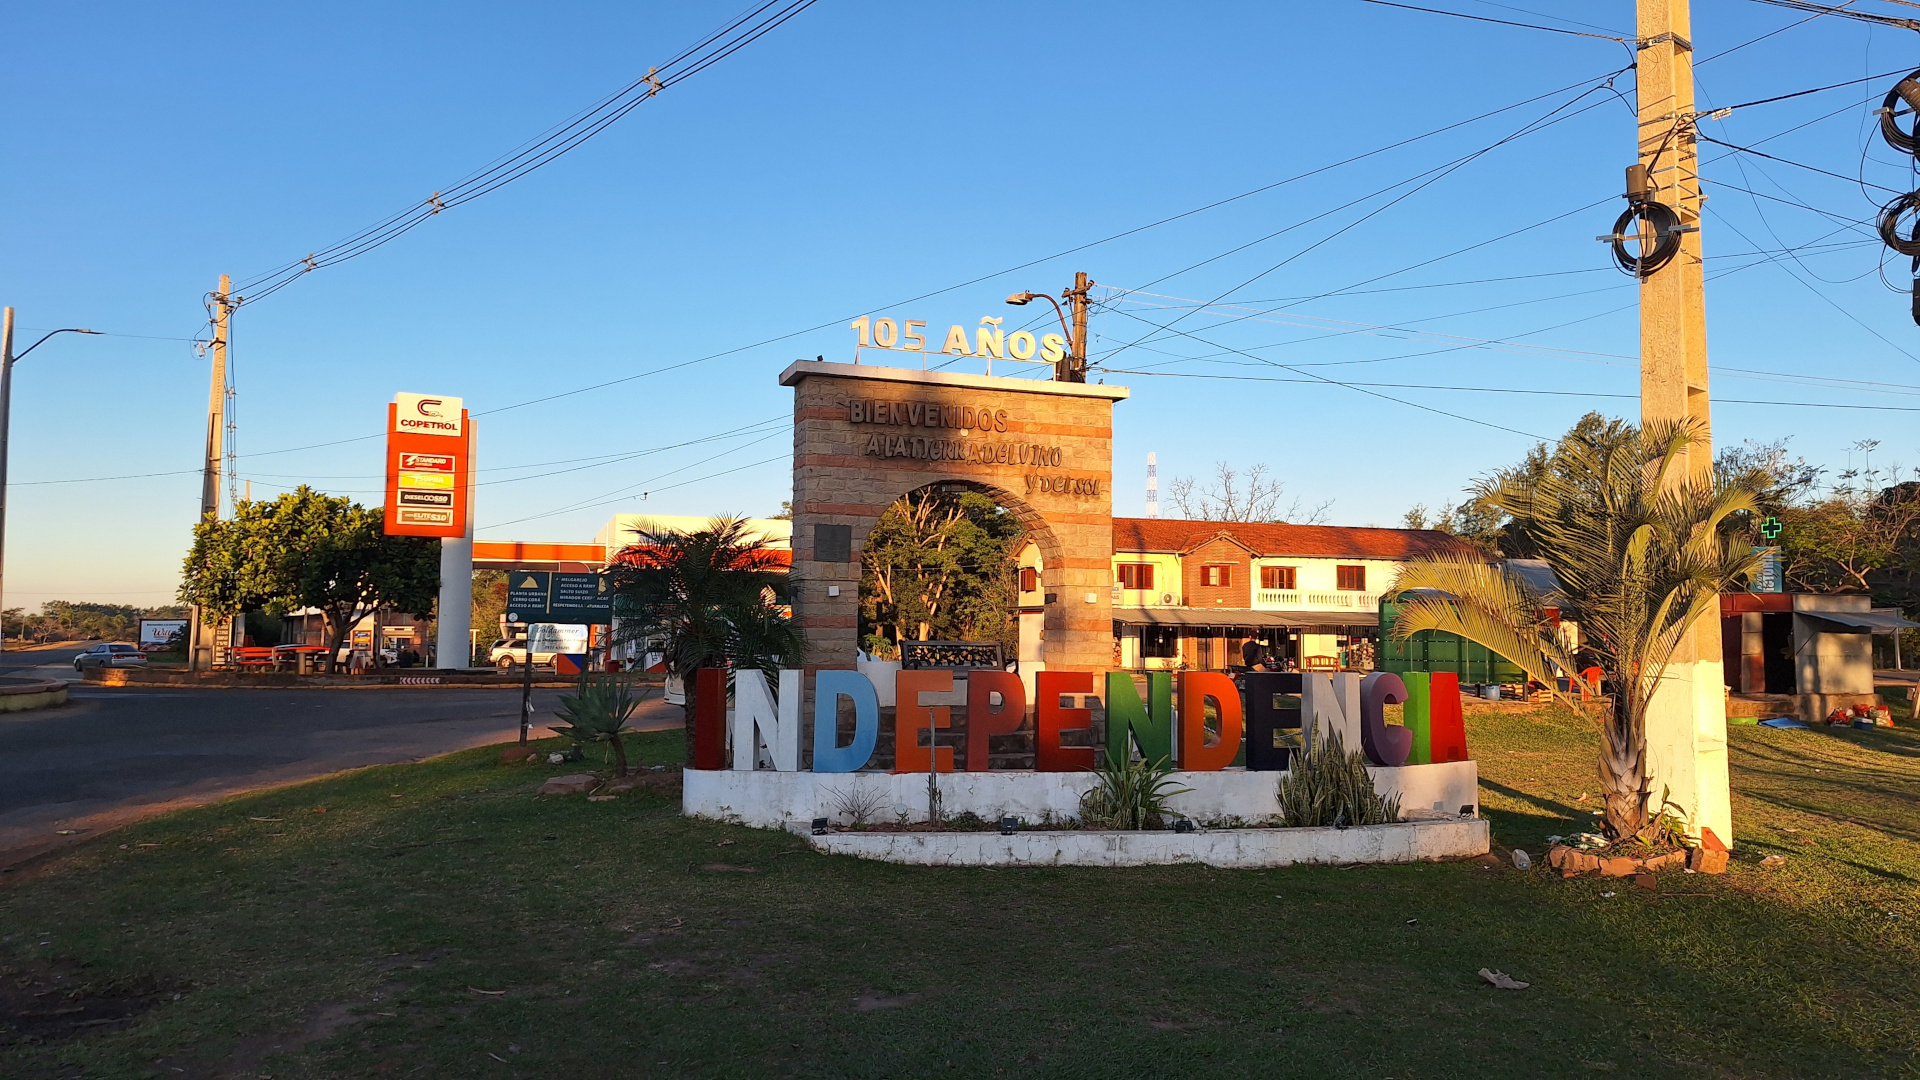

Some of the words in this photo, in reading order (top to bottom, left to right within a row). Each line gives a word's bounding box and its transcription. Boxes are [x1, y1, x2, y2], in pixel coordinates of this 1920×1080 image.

[850, 315, 927, 350] 105
[942, 315, 1065, 363] AÑOS
[400, 419, 458, 430] COPETROL
[850, 399, 1008, 433] BIENVENIDOS
[1018, 443, 1062, 467] VINO
[1073, 477, 1100, 496] SOL
[695, 667, 1469, 773] INDEPENDENCIA
